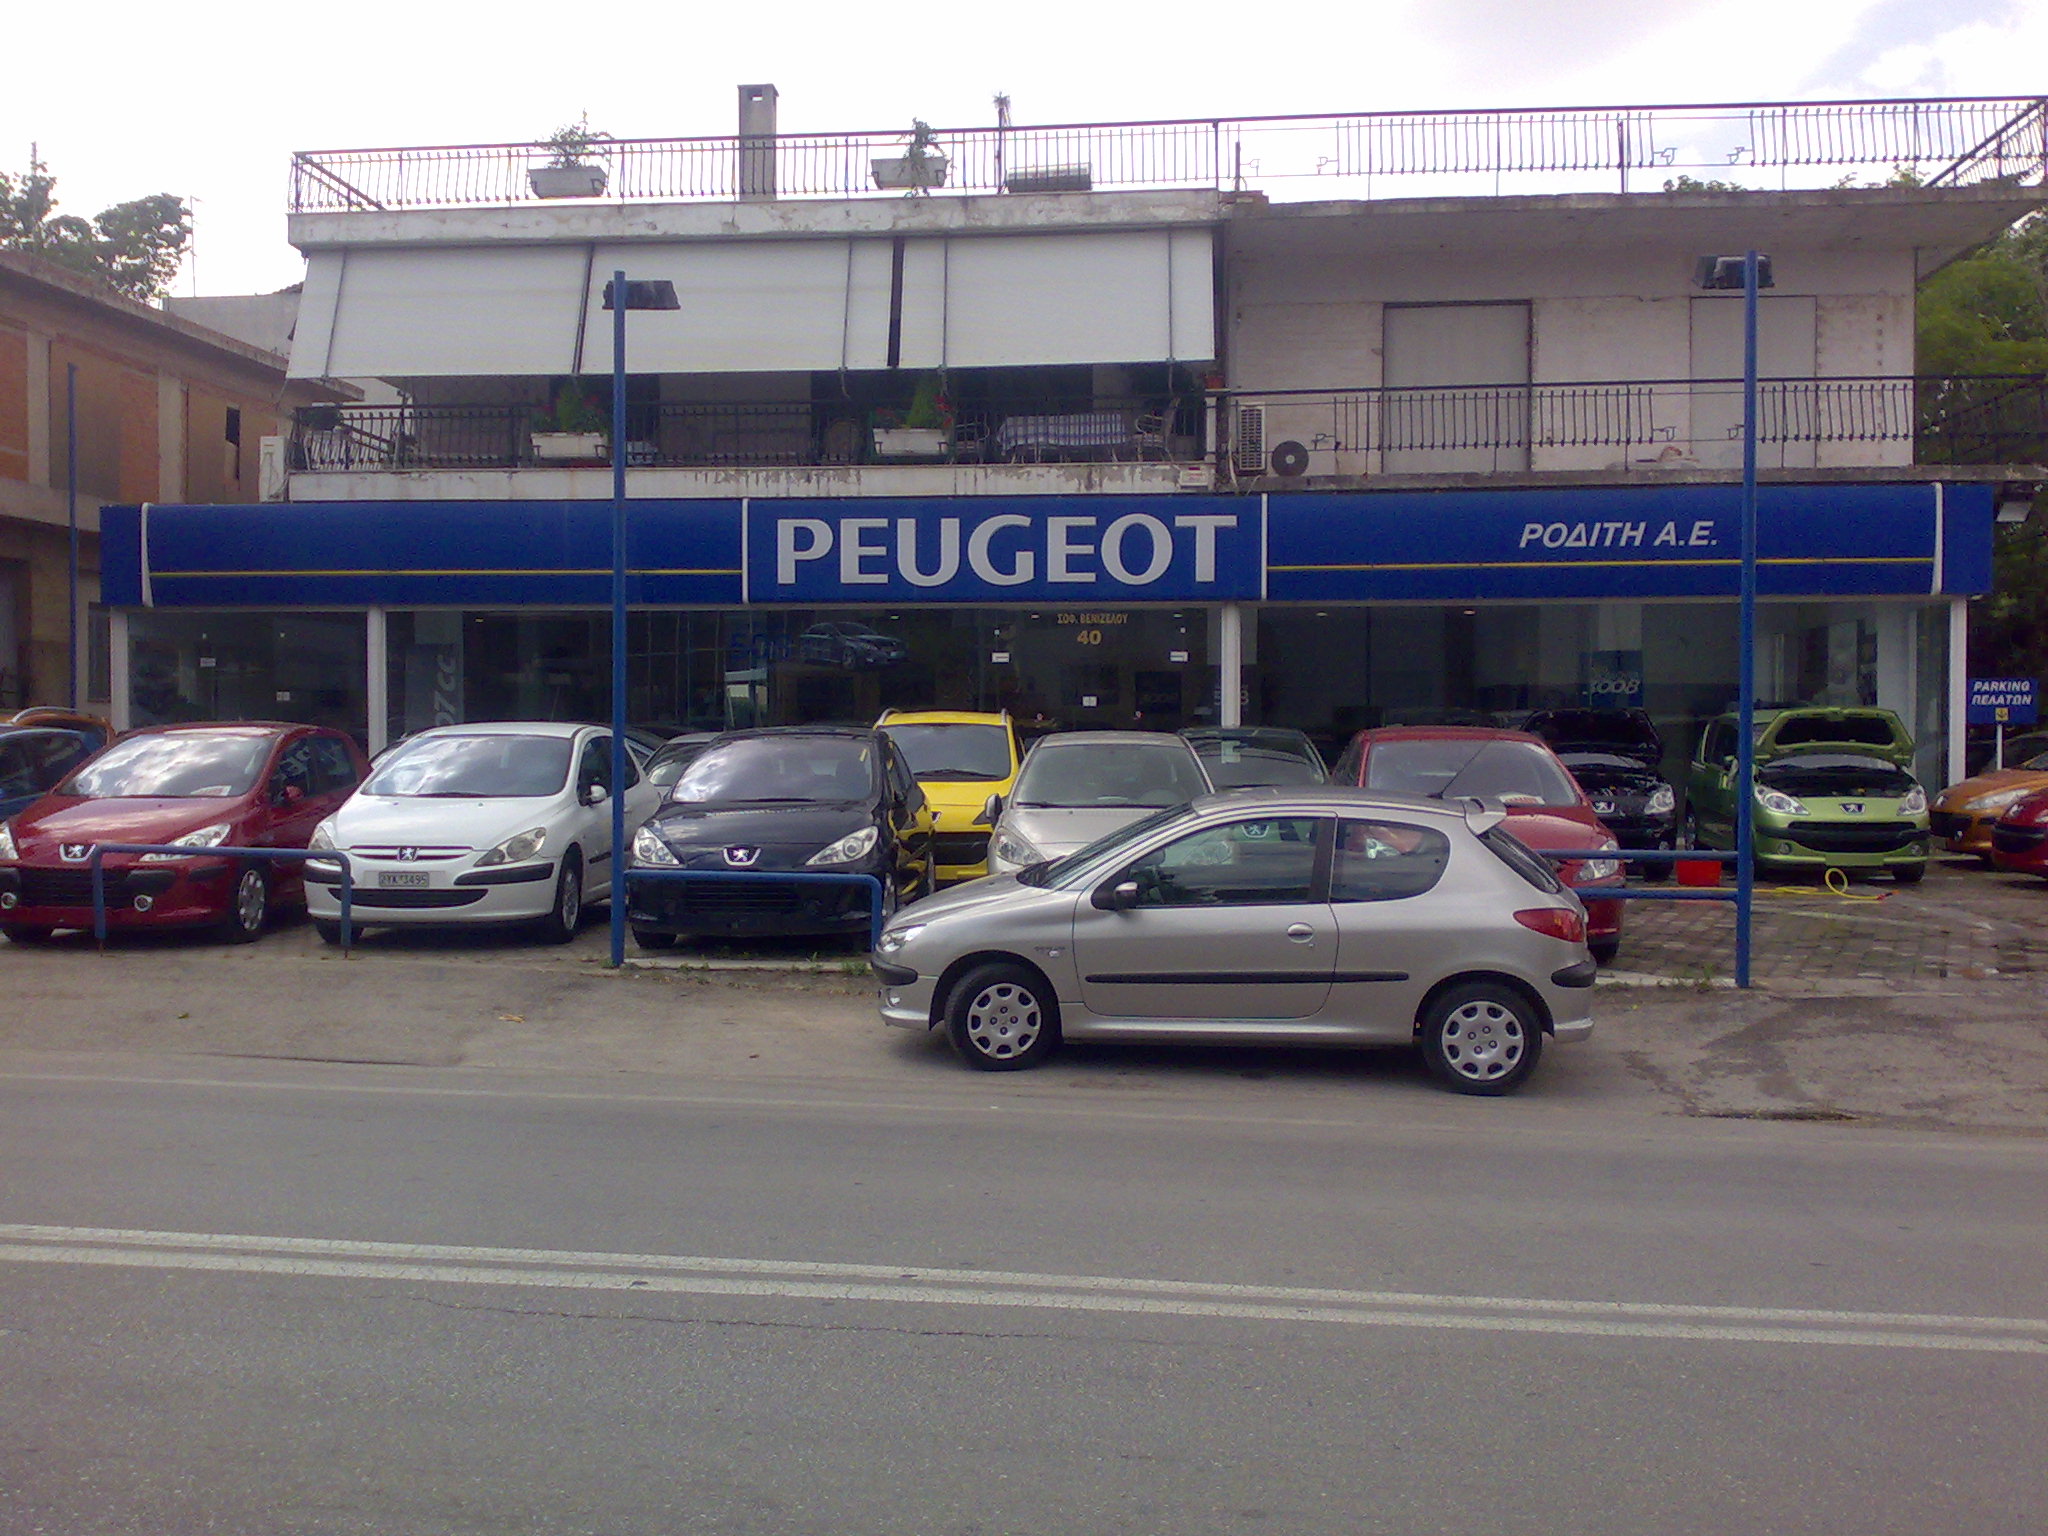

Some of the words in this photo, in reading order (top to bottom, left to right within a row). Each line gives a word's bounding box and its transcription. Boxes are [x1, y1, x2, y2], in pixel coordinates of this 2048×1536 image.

[1519, 521, 1646, 548] ΡΟΔΙΤΗ
[1653, 520, 1718, 547] Α.Ε.
[777, 513, 1237, 587] PEUGEOT
[1077, 630, 1102, 645] 40
[1973, 680, 2030, 692] PARKING
[1971, 694, 2032, 705] ΠΕΛΑΤΩΝ
